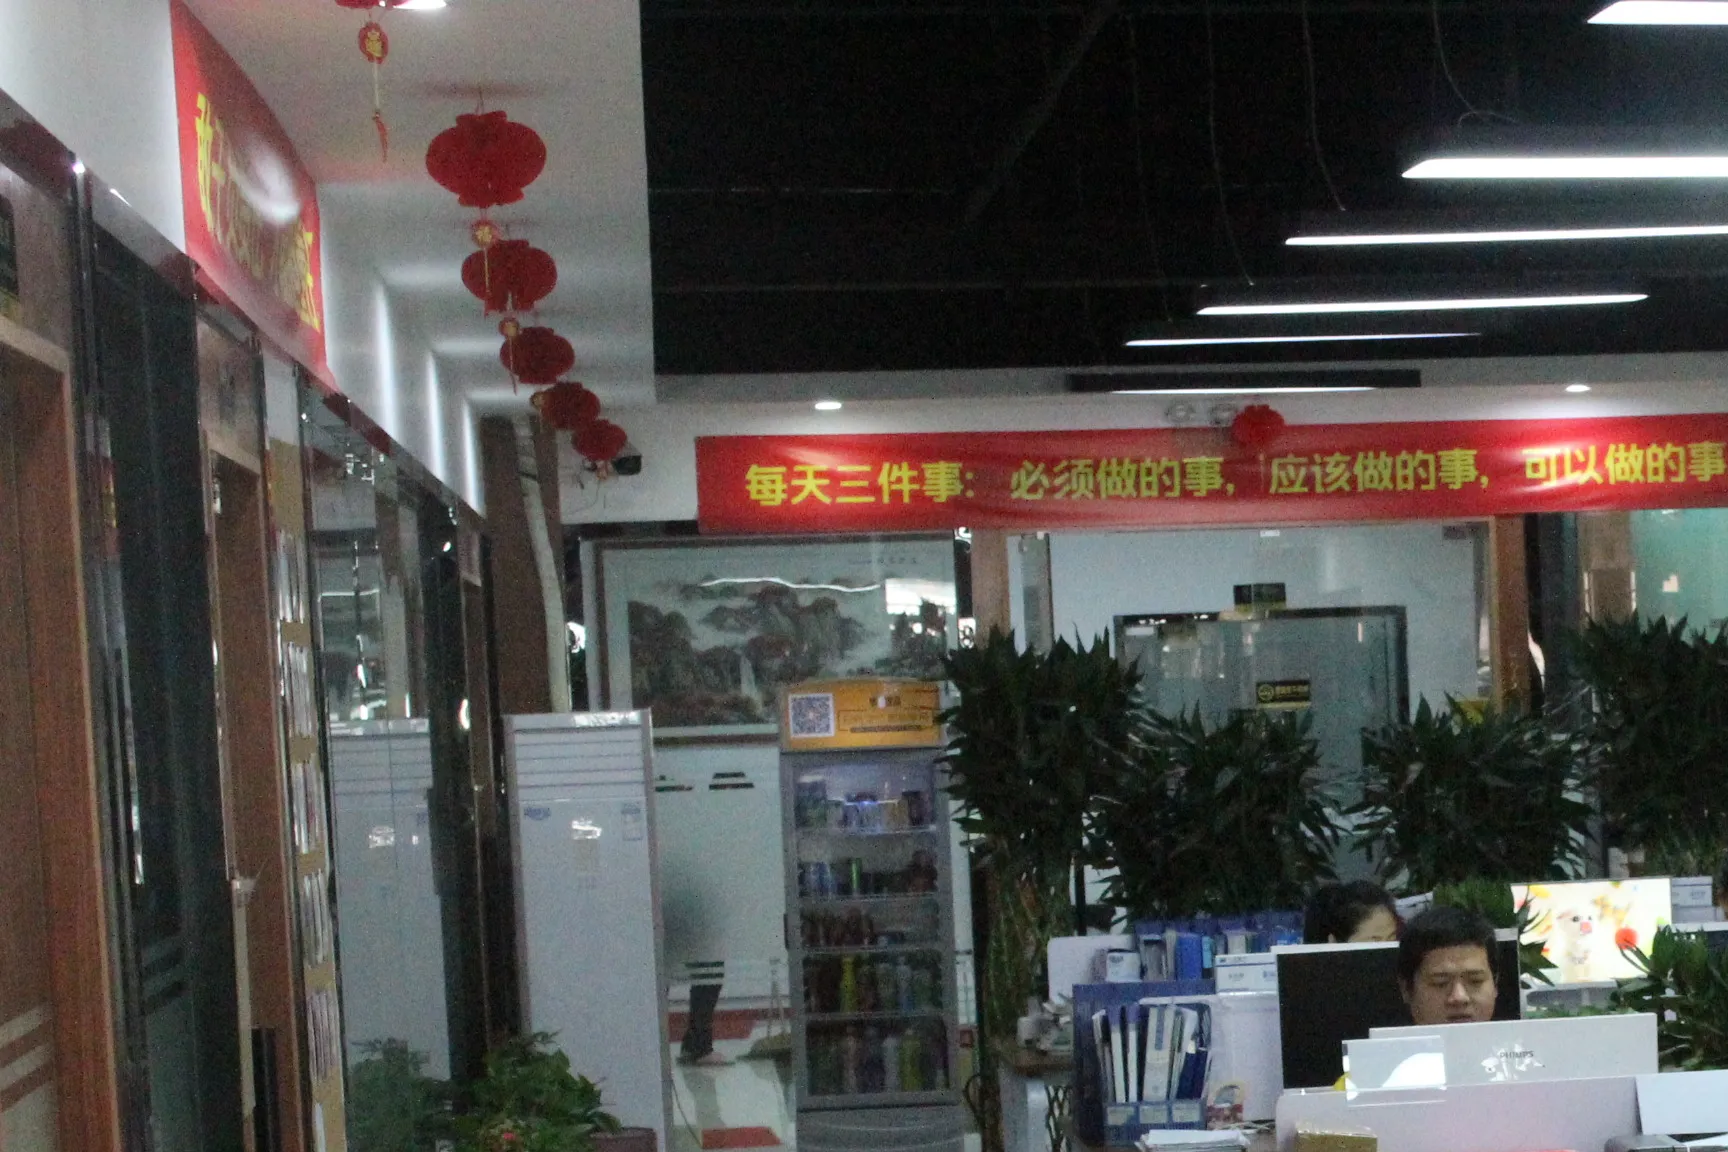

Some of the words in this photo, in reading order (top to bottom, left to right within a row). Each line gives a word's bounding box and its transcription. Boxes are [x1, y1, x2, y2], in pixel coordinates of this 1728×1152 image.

[745, 461, 975, 507] 每天三件事：
